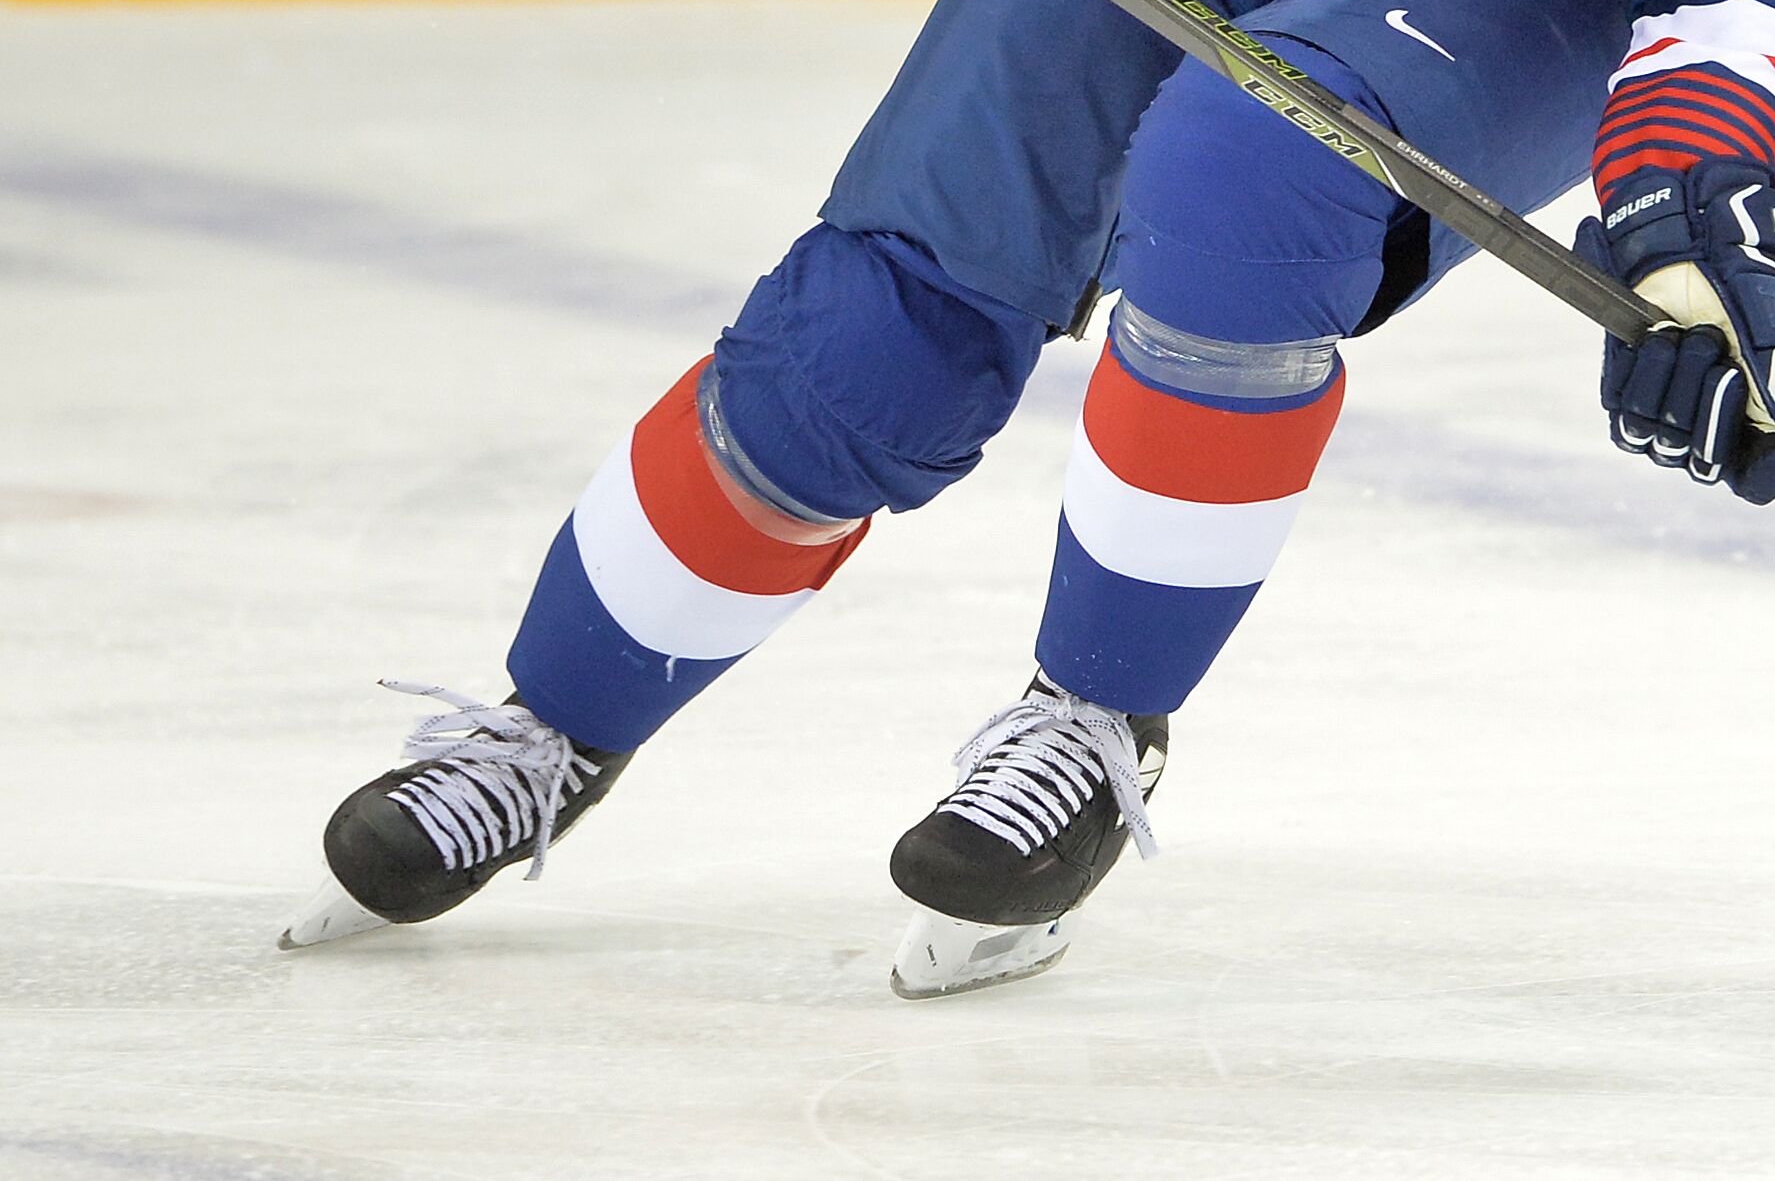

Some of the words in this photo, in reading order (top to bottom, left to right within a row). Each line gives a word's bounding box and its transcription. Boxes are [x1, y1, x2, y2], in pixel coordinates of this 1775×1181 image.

[1241, 74, 1367, 159] CCM
[1396, 140, 1468, 190] EHRHARDT
[1605, 186, 1672, 230] BAUER
